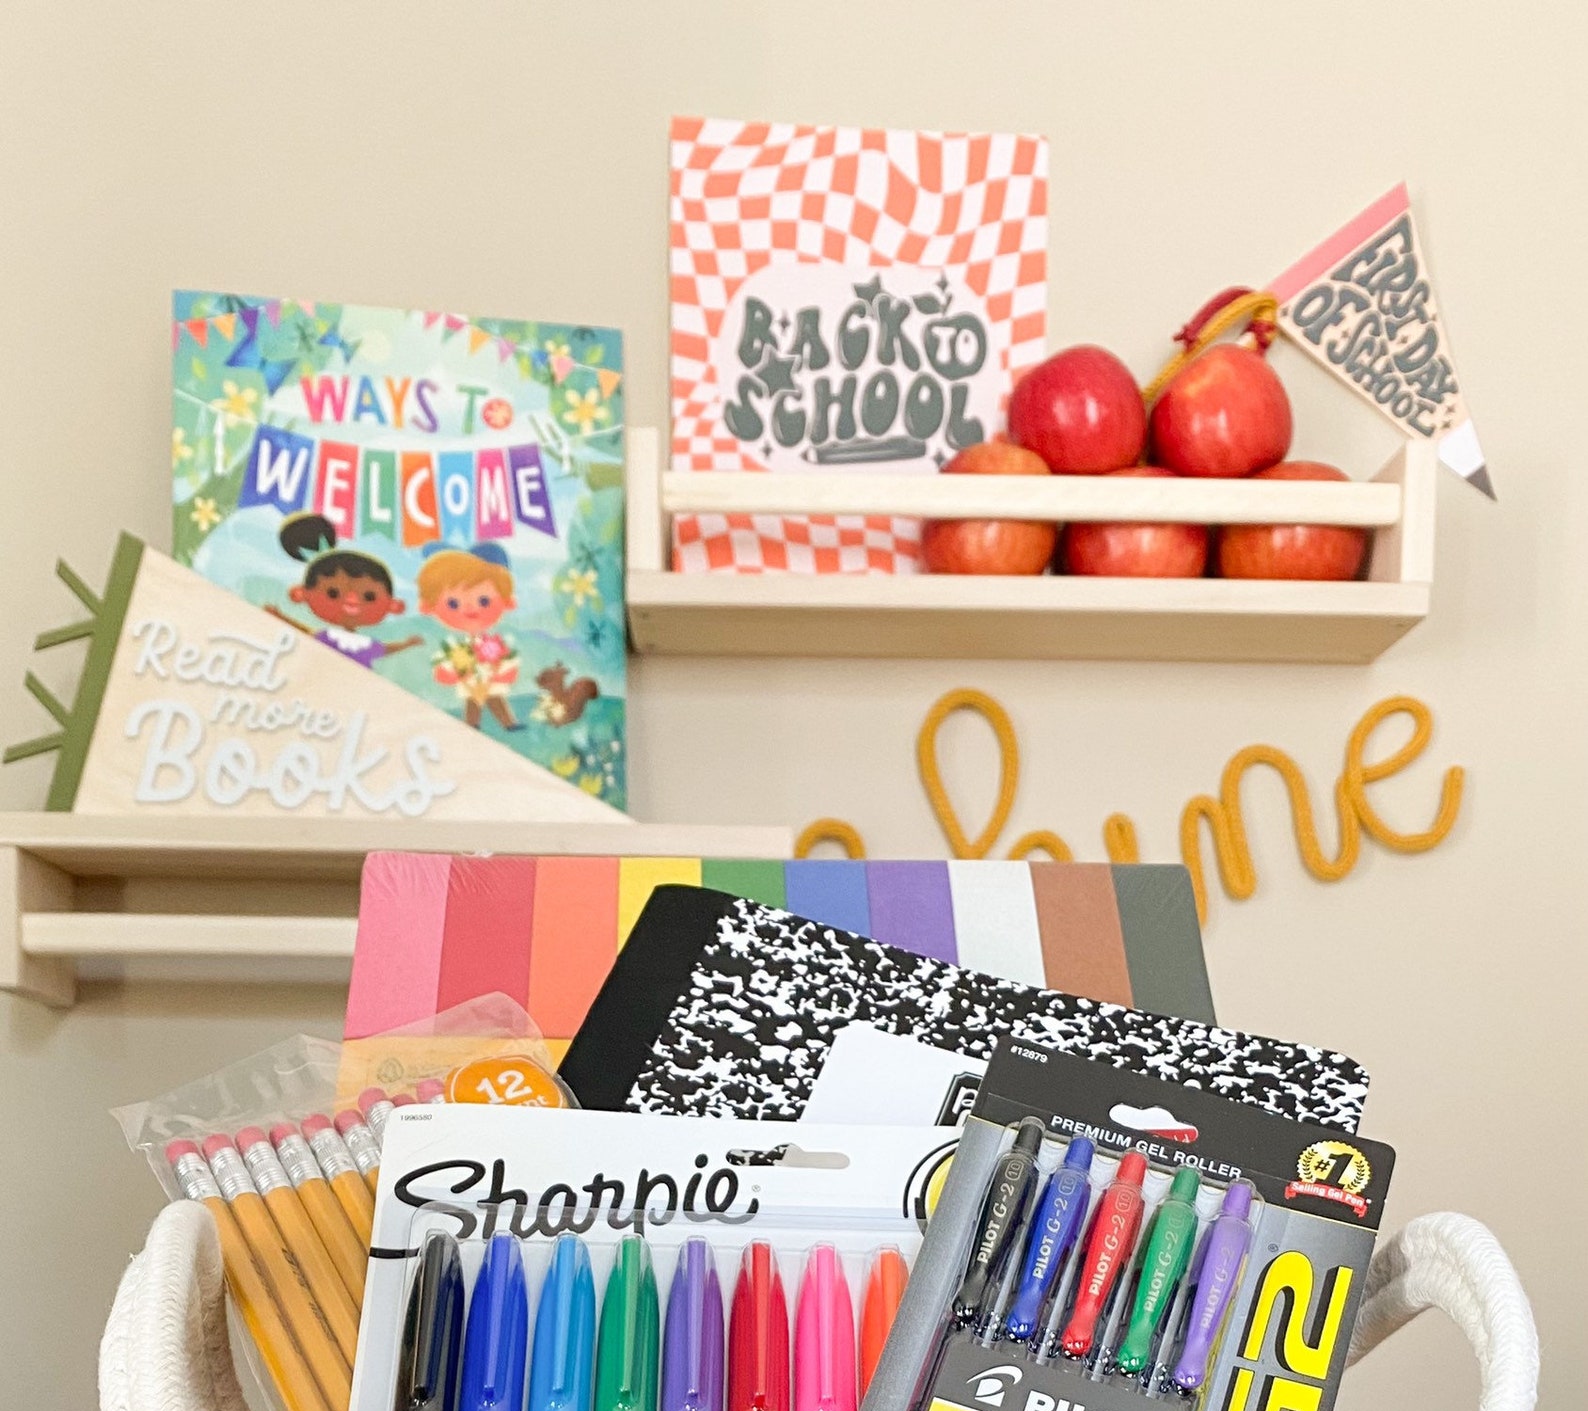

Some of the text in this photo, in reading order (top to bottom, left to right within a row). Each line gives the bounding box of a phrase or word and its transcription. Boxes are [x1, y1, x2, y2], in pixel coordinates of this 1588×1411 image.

[737, 293, 920, 372] BACK
[1331, 213, 1459, 404] FIRST DAY
[1292, 283, 1437, 437] OF SCHOOL
[300, 375, 440, 434] WAYS
[724, 369, 985, 449] SCHOOL
[256, 438, 547, 529] WELCOME
[131, 620, 297, 692] Read
[211, 693, 343, 738] more
[125, 699, 457, 818] Books
[475, 1069, 533, 1104] 12
[1010, 1045, 1048, 1063] #12879
[1050, 1115, 1243, 1179] PREMIUM GEL ROLLER
[394, 1152, 760, 1240] Sharpie
[976, 1220, 1001, 1264] PILOT
[992, 1183, 1015, 1218] G-2
[1291, 1181, 1366, 1208] Selling Gel Pen
[1032, 1235, 1055, 1280] PILOT
[1046, 1197, 1068, 1233] G-2
[1088, 1251, 1112, 1296] PILOT
[1104, 1214, 1126, 1250] G-2
[1143, 1268, 1166, 1312] PILOT
[1159, 1231, 1179, 1267] G-2
[1201, 1284, 1221, 1329] PILOT
